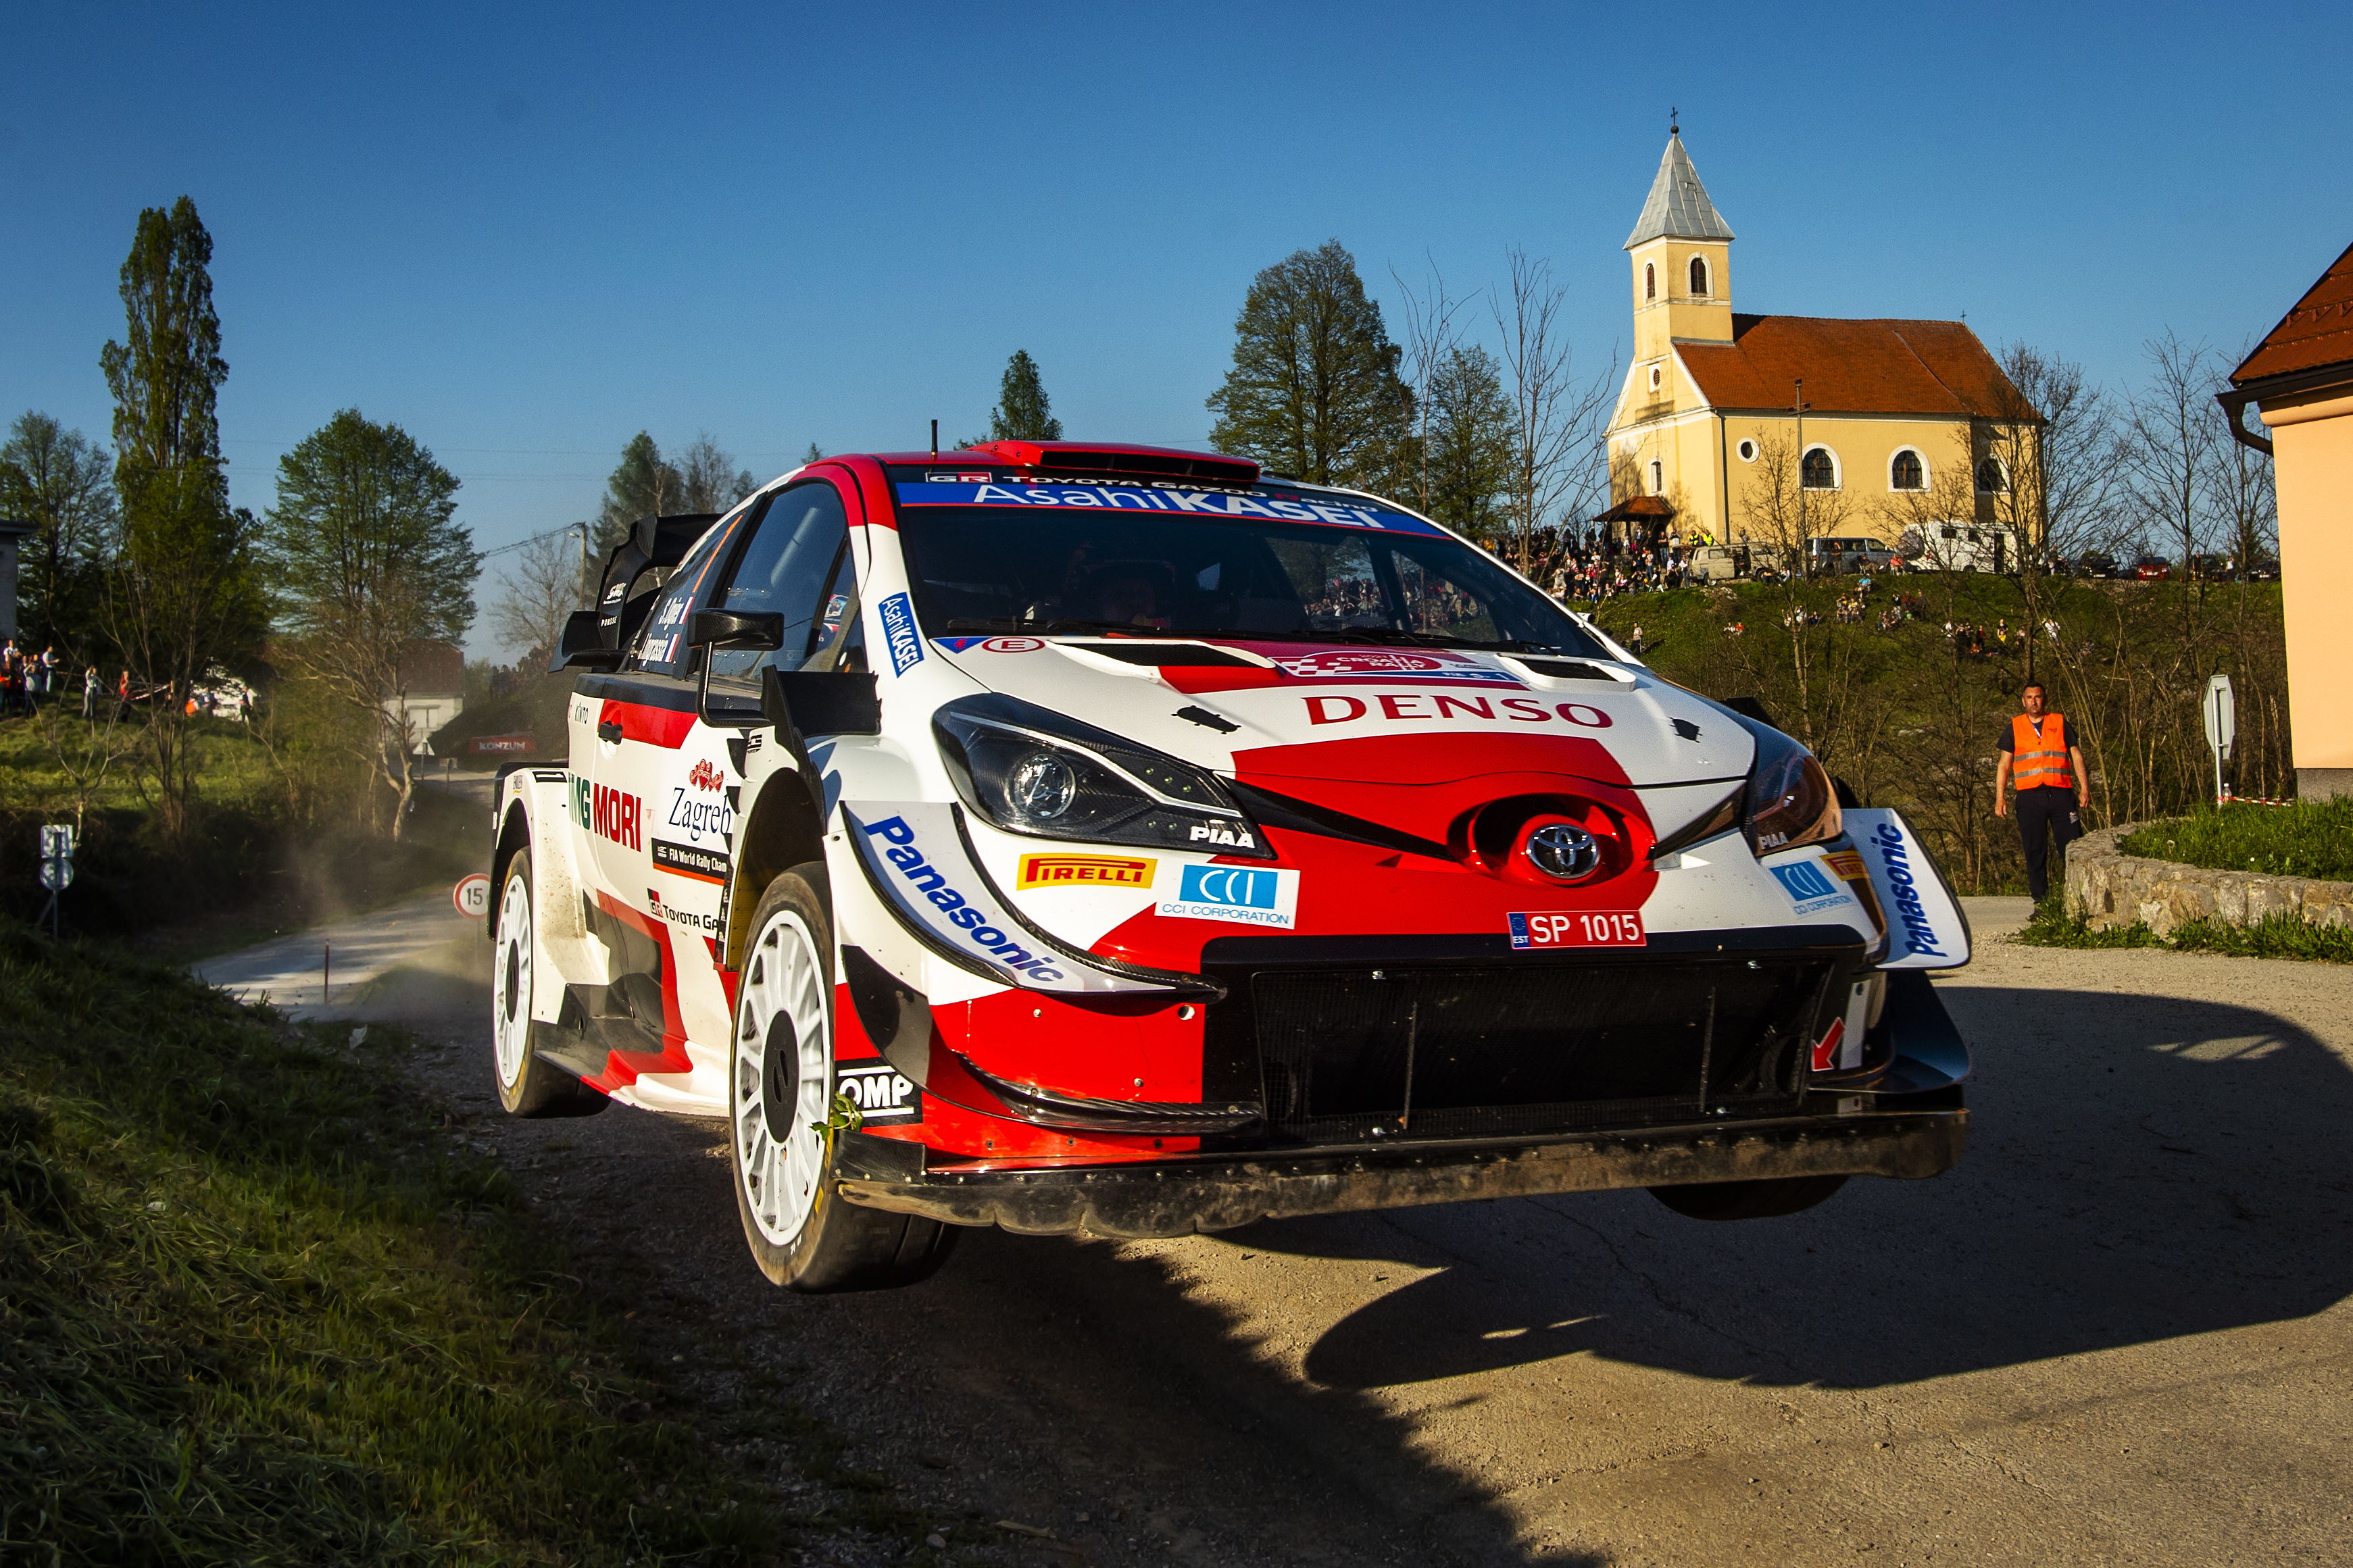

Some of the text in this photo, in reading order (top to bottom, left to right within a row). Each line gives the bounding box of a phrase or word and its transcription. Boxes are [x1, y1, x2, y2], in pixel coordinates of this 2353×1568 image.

[974, 484, 1385, 529] AsahiKASEI
[1003, 476, 1142, 487] TOYOTA
[1151, 482, 1268, 497] GAZOO
[1274, 492, 1378, 513] Racing
[882, 597, 919, 672] AsahiKASEI
[1000, 640, 1026, 649] E
[1301, 694, 1613, 728] DENSO
[478, 741, 526, 751] KONZUM
[593, 782, 641, 853] MORI
[668, 786, 731, 842] Zagreb
[1189, 826, 1256, 849] PIAA
[1758, 832, 1790, 850] PIAA
[670, 848, 679, 862] FIA
[680, 851, 695, 866] World
[696, 853, 710, 871] Rally
[1025, 858, 1146, 883] PIRELLI
[467, 888, 482, 905] 15
[863, 815, 1064, 982] Panasonic
[1199, 869, 1254, 905] CCI
[1871, 823, 1949, 957] Panasonic
[662, 905, 701, 928] TOYOTA
[1162, 903, 1289, 925] CCI CORPORATION
[1512, 935, 1529, 944] EST
[1530, 915, 1640, 943] SP 1015
[839, 1074, 914, 1108] OMP
